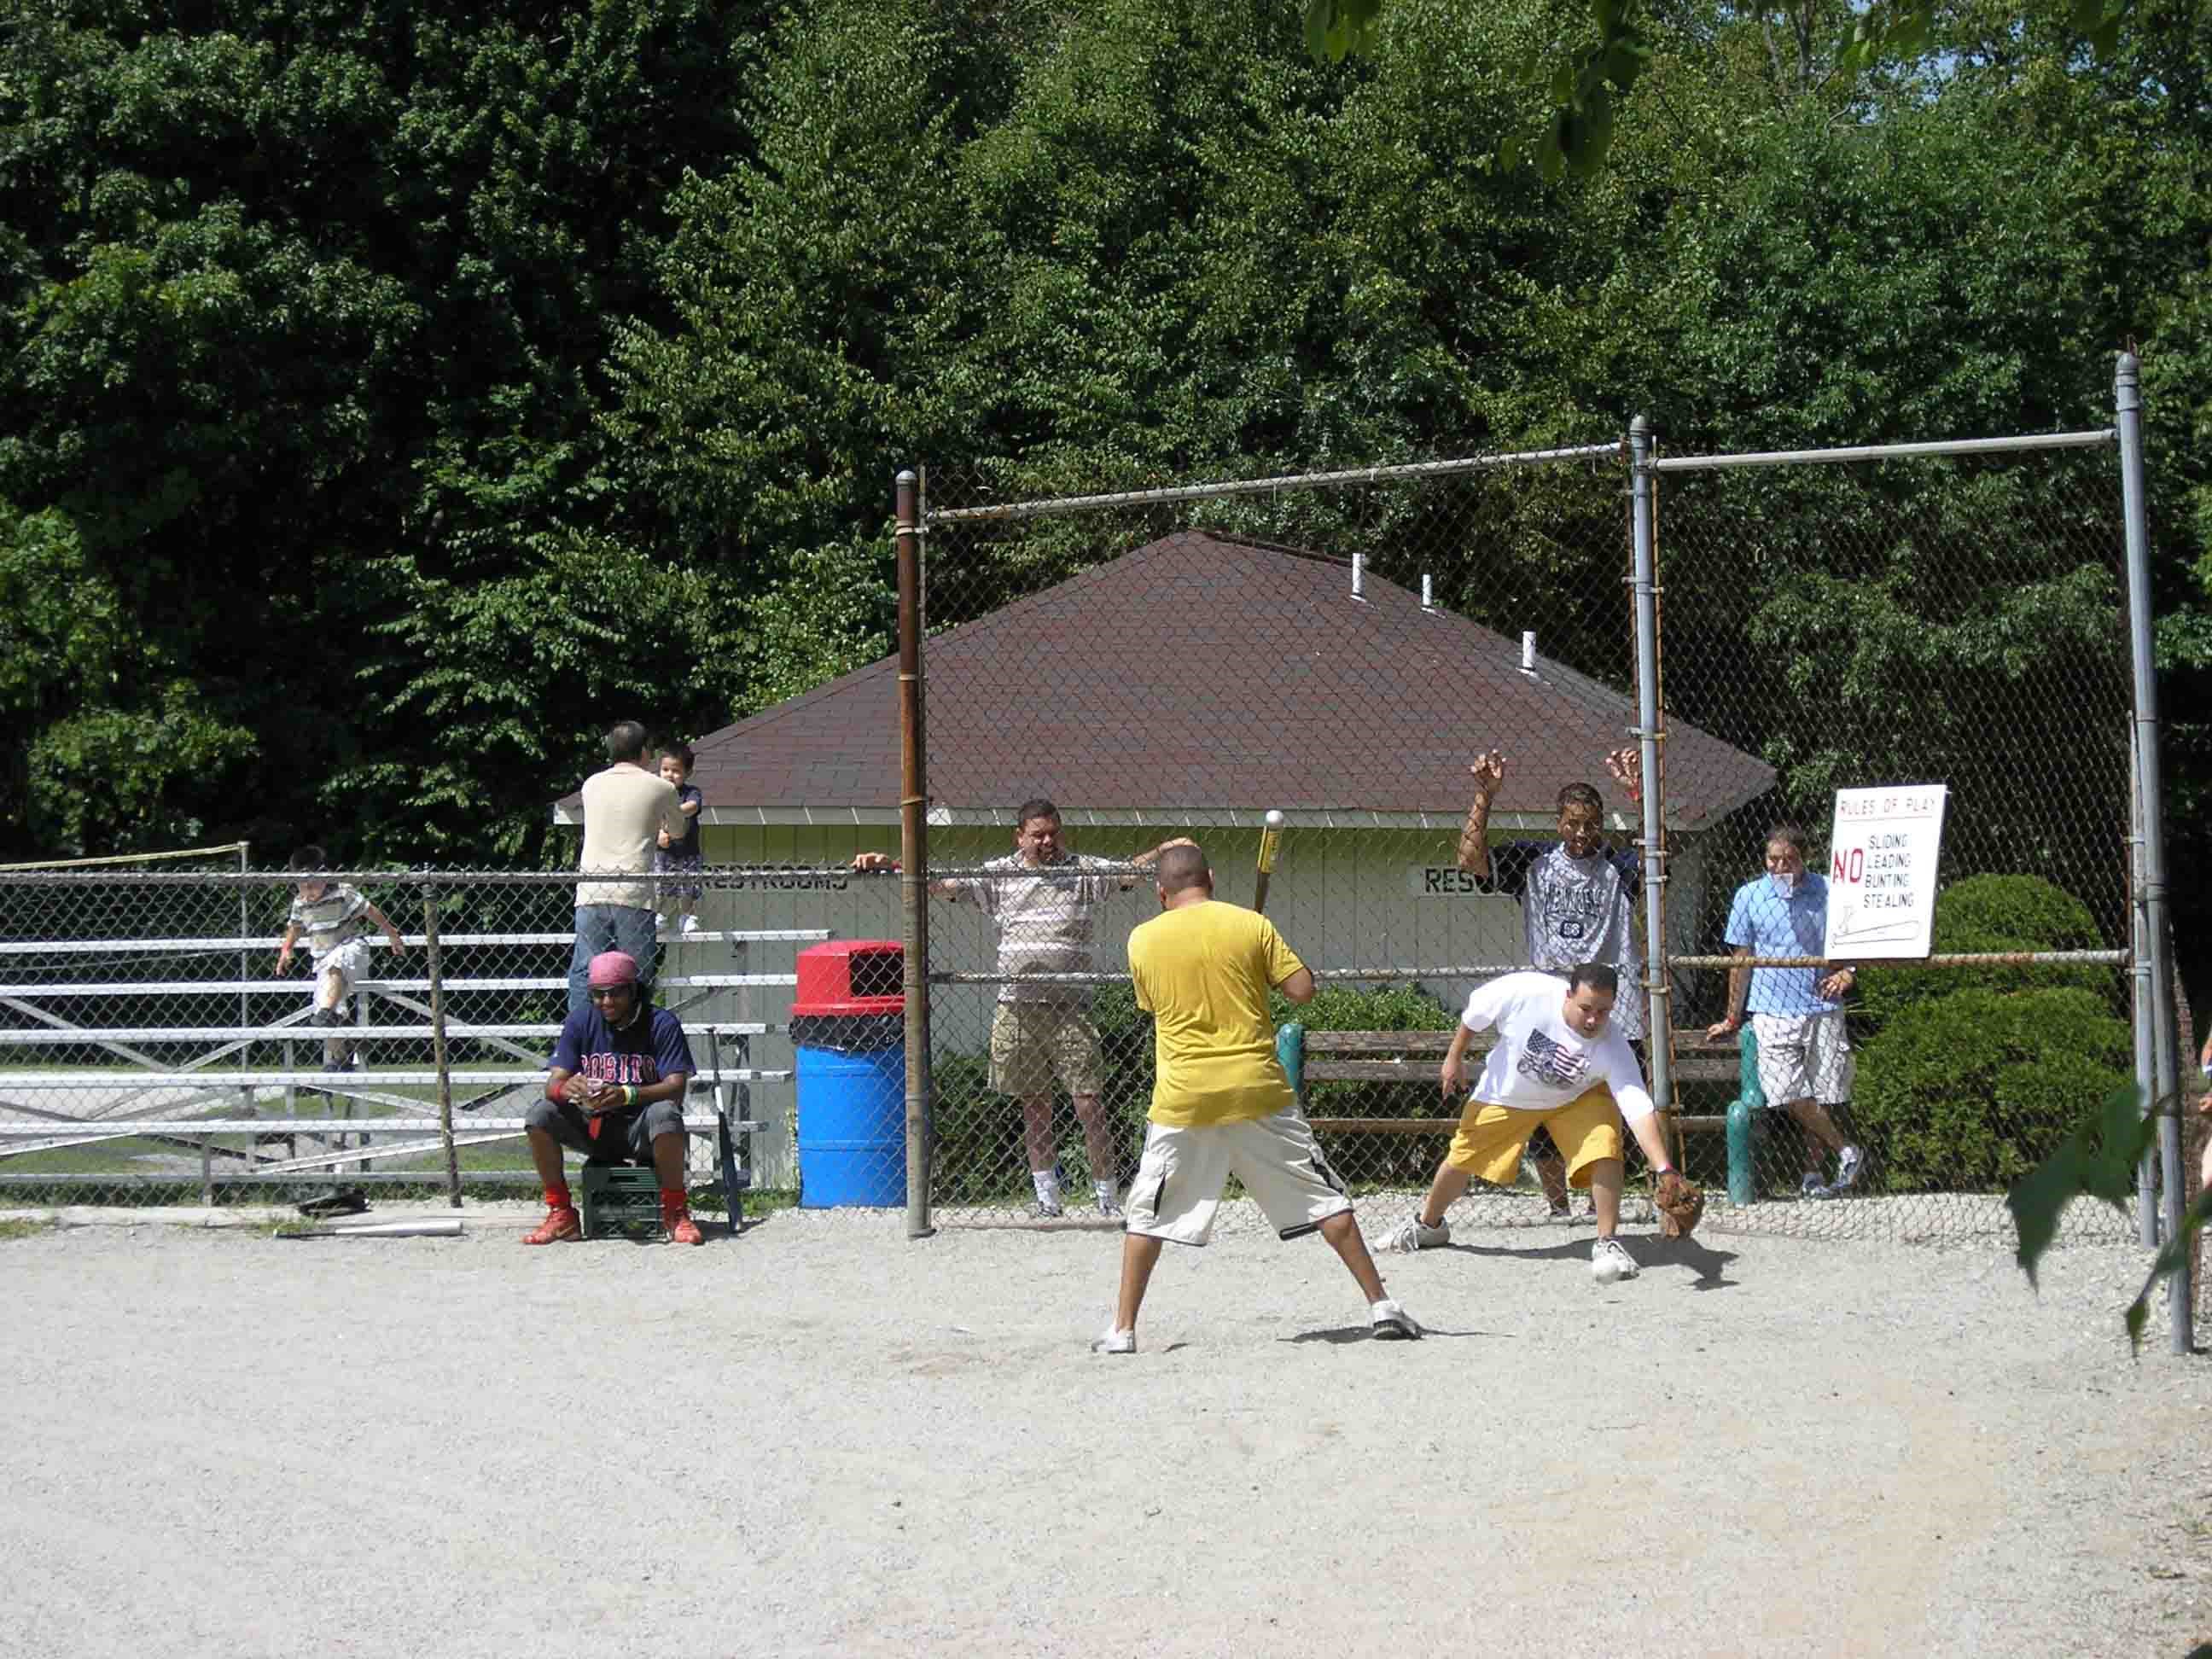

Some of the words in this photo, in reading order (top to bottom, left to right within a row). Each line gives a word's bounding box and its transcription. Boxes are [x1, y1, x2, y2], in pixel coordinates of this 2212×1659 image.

[1841, 800, 1876, 816] RULES
[1884, 798, 1898, 813] OF
[1906, 797, 1936, 812] PLAY
[1868, 834, 1908, 850] SLIDING
[1832, 848, 1864, 884] NO
[1866, 853, 1912, 869] LEADING
[1865, 873, 1910, 888] BUNTING
[1863, 893, 1915, 909] STEALING
